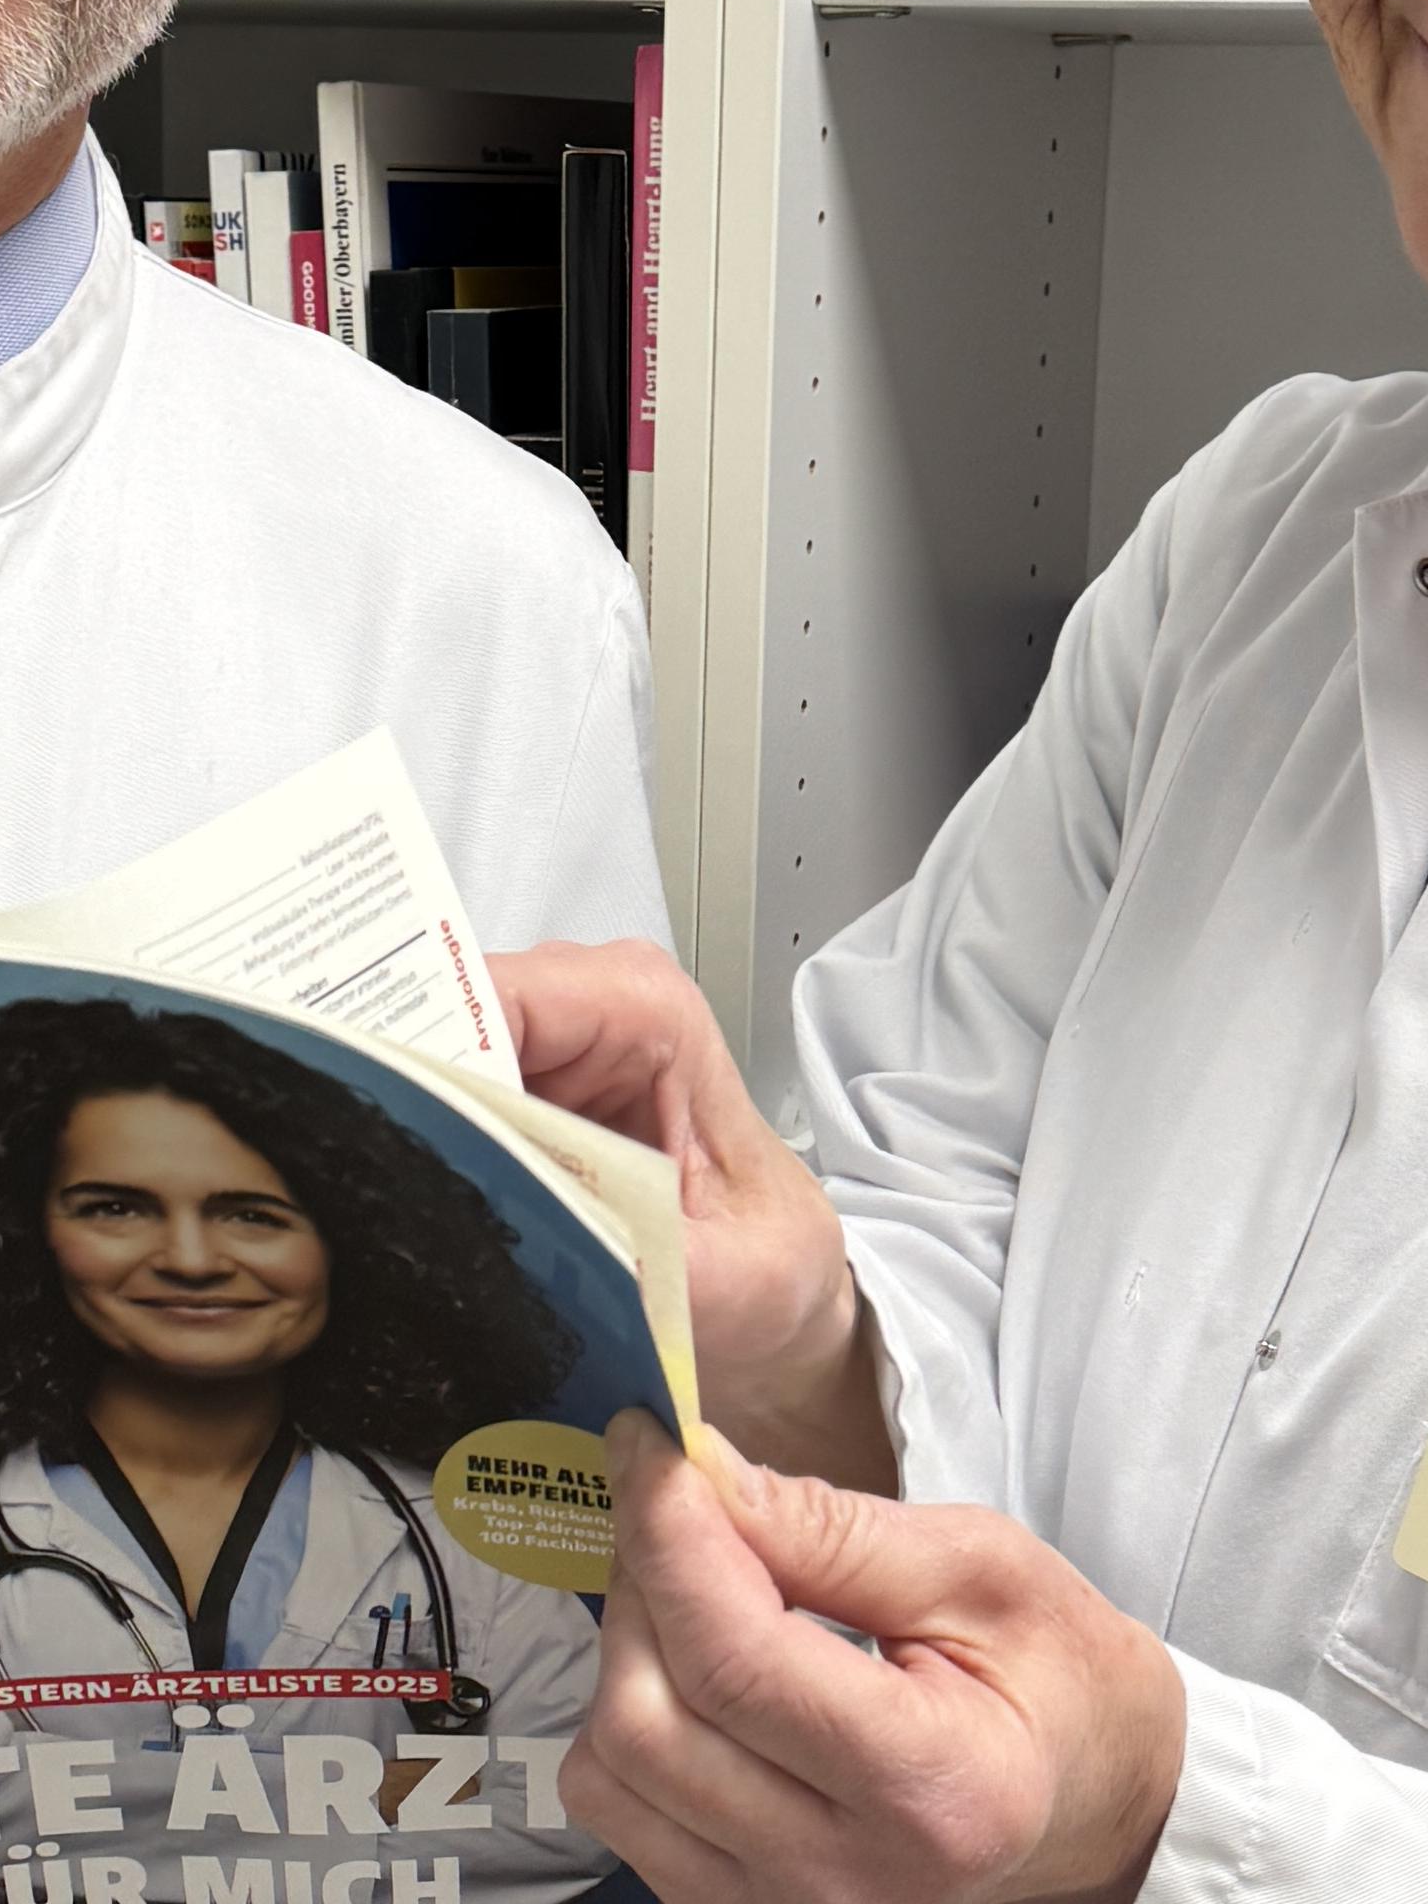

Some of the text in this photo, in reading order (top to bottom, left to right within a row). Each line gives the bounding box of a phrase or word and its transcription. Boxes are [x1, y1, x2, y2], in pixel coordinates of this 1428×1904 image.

[214, 211, 243, 230] UK
[215, 233, 243, 251] SH
[440, 919, 490, 1050] Angiologie
[468, 1455, 607, 1491] MEHR ALS
[466, 1476, 612, 1511] EMPFEHLU
[351, 1673, 440, 1696] 2025
[166, 1703, 571, 1835] ÄRZT
